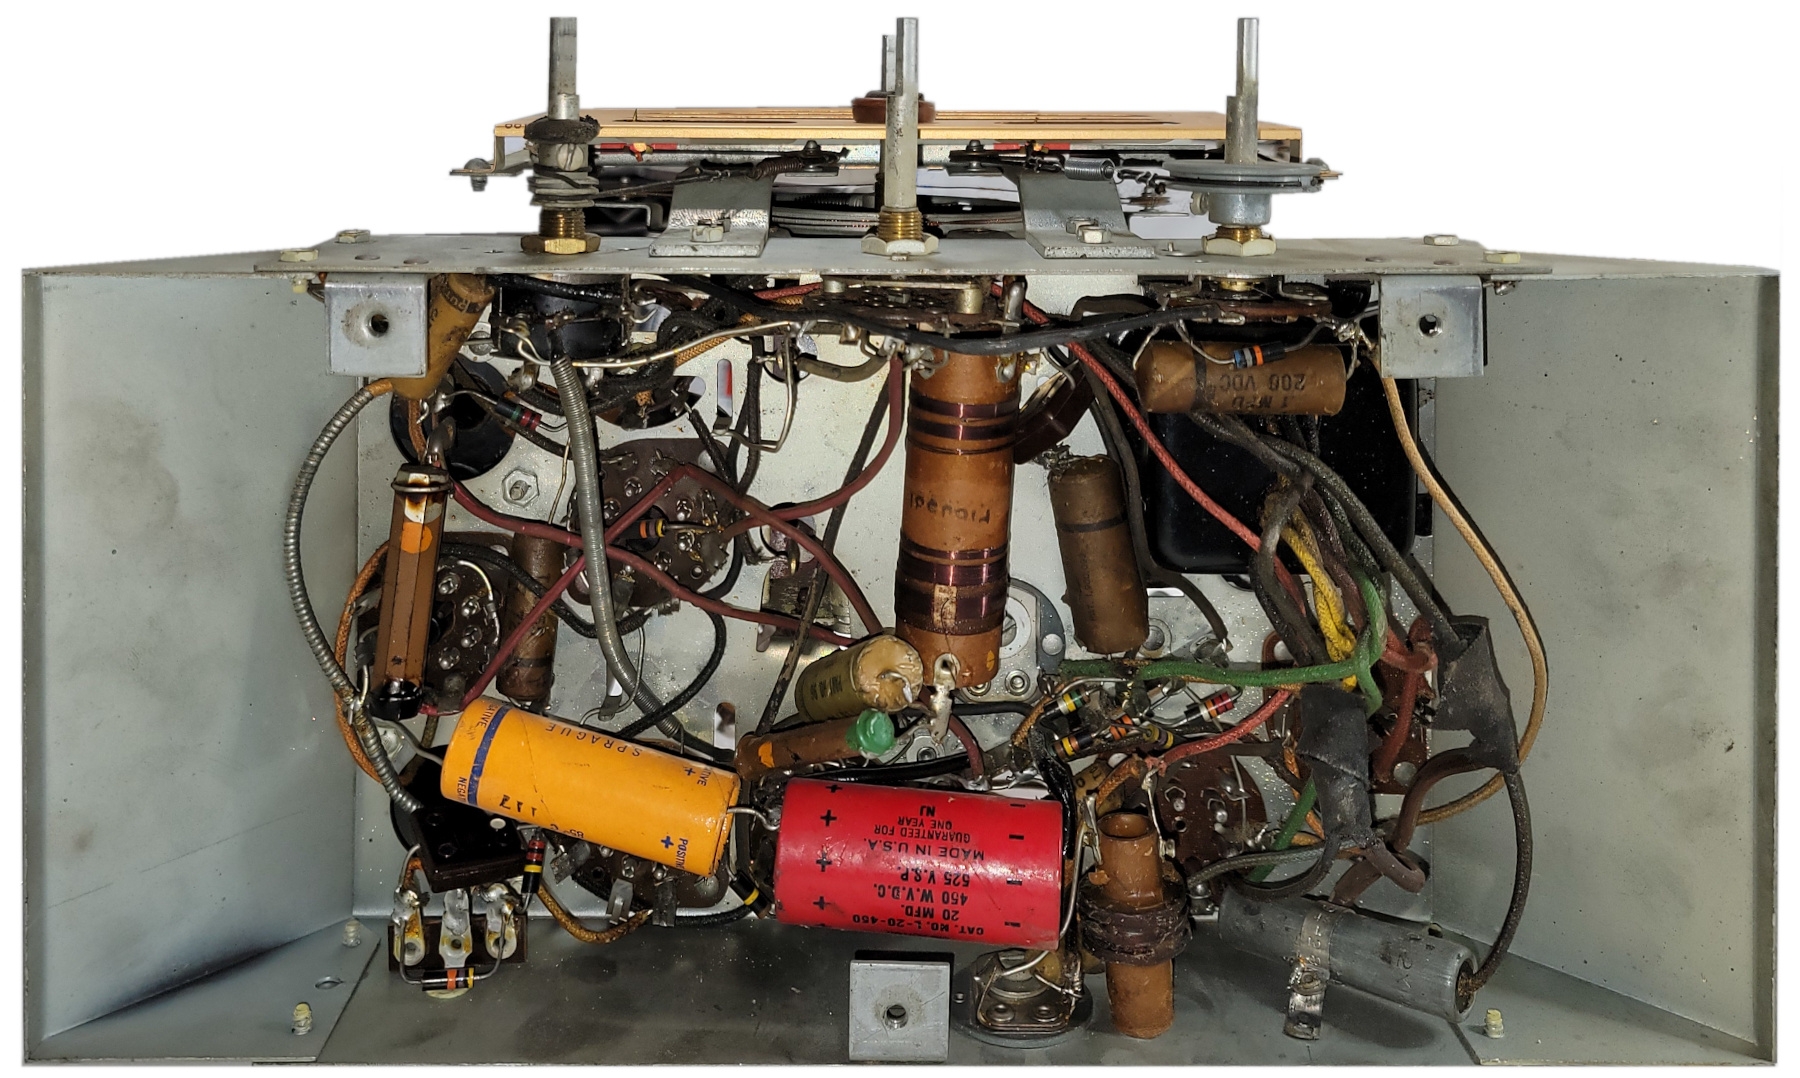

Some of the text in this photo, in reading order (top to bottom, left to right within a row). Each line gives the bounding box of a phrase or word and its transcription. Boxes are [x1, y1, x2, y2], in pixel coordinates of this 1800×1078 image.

[1219, 373, 1305, 391] 200 VDC
[545, 722, 641, 757] SPRAGUE
[919, 805, 936, 818] NJ
[897, 816, 953, 830] ONE YEAR
[874, 824, 971, 843] GUARANTEED FOR
[863, 838, 985, 861] MADE IN U.S.A.
[896, 866, 970, 887] 525 V.S.P.
[872, 883, 968, 905] 450 W.V.D.C.
[900, 904, 960, 922] 20 MFD.
[852, 914, 923, 931] L-20-450
[926, 920, 950, 932] NO.
[954, 923, 985, 936] CAT.
